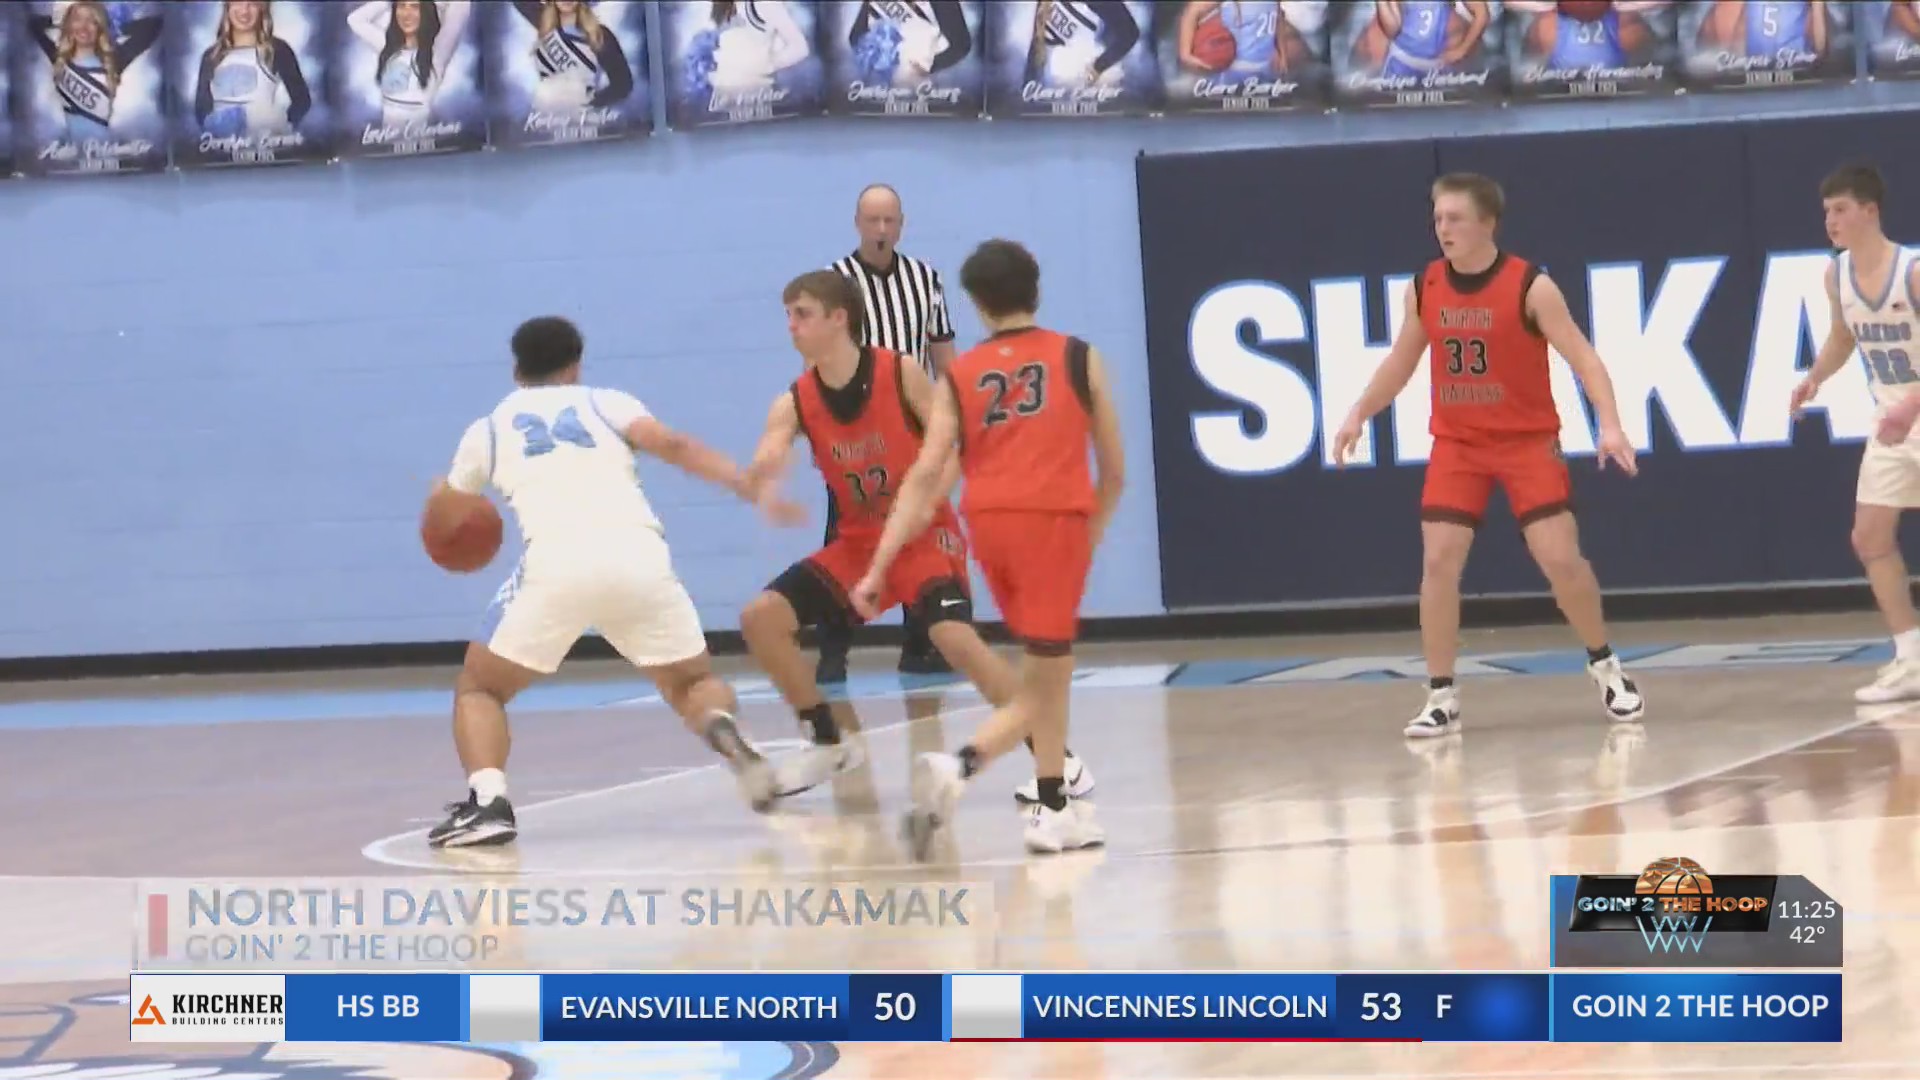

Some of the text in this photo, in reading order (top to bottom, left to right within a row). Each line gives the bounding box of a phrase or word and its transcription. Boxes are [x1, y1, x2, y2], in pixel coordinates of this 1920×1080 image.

[1256, 11, 1278, 37] 20
[1419, 10, 1432, 36] 3
[1763, 6, 1777, 37] 5
[1444, 337, 1488, 376] 33
[977, 360, 1046, 428] 23
